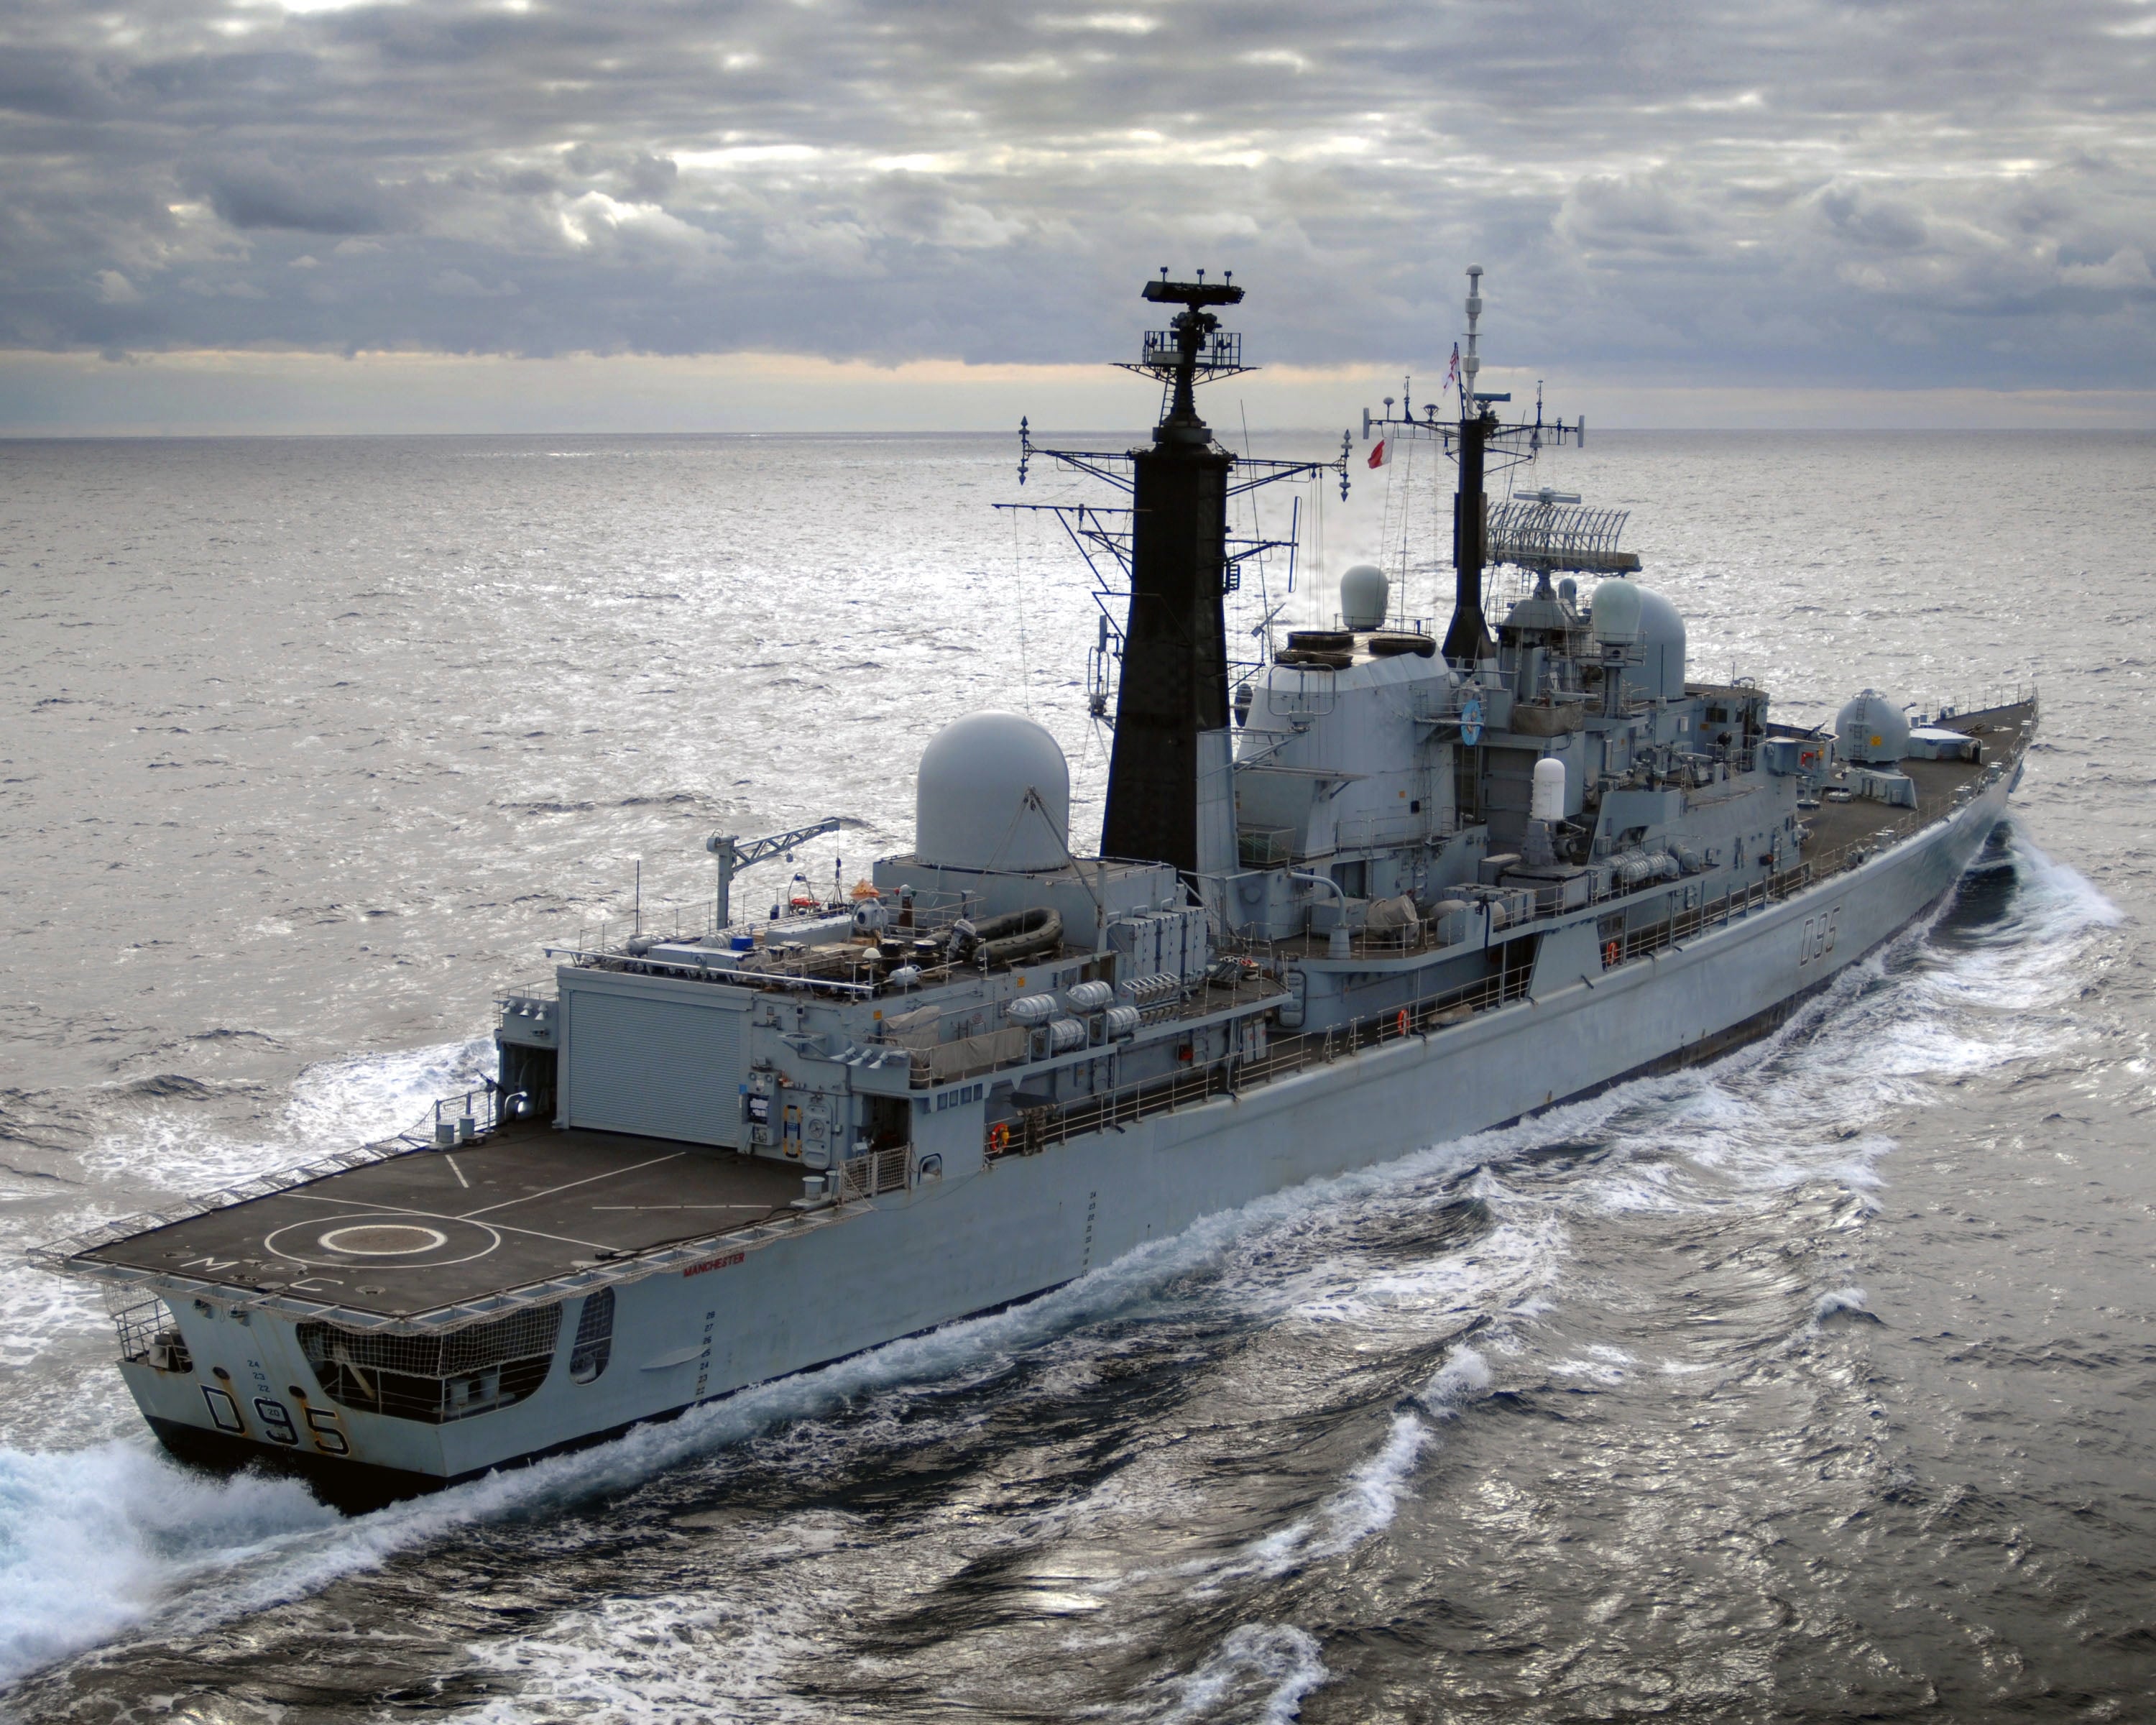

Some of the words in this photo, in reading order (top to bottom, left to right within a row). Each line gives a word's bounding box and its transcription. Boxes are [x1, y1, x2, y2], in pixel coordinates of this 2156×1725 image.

[1800, 906, 1840, 967] D95
[683, 1253, 745, 1277] MANCHESTER
[706, 1311, 715, 1320] 28
[705, 1323, 713, 1332] 27
[703, 1336, 711, 1345] 26
[247, 1360, 259, 1368] 24
[267, 1409, 280, 1417] 20
[199, 1383, 349, 1457] D95
